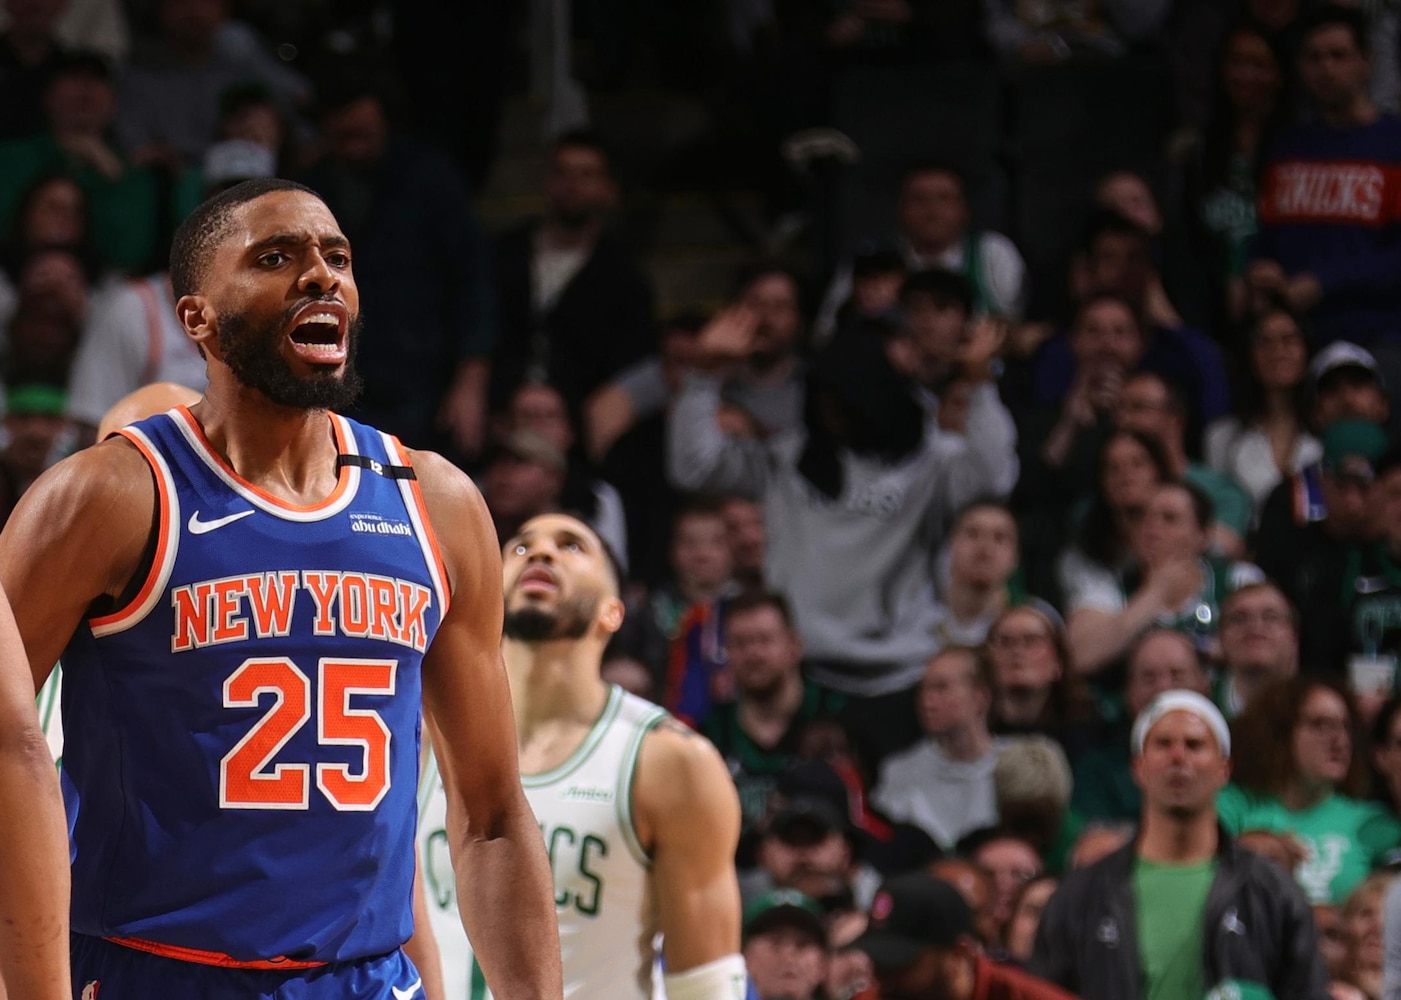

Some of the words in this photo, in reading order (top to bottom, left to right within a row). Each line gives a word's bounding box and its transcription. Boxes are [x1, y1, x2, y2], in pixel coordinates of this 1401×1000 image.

[352, 520, 376, 532] abu
[377, 521, 411, 536] dhabi
[171, 570, 299, 653] NEW
[302, 570, 431, 653] YORK
[219, 657, 398, 811] 25
